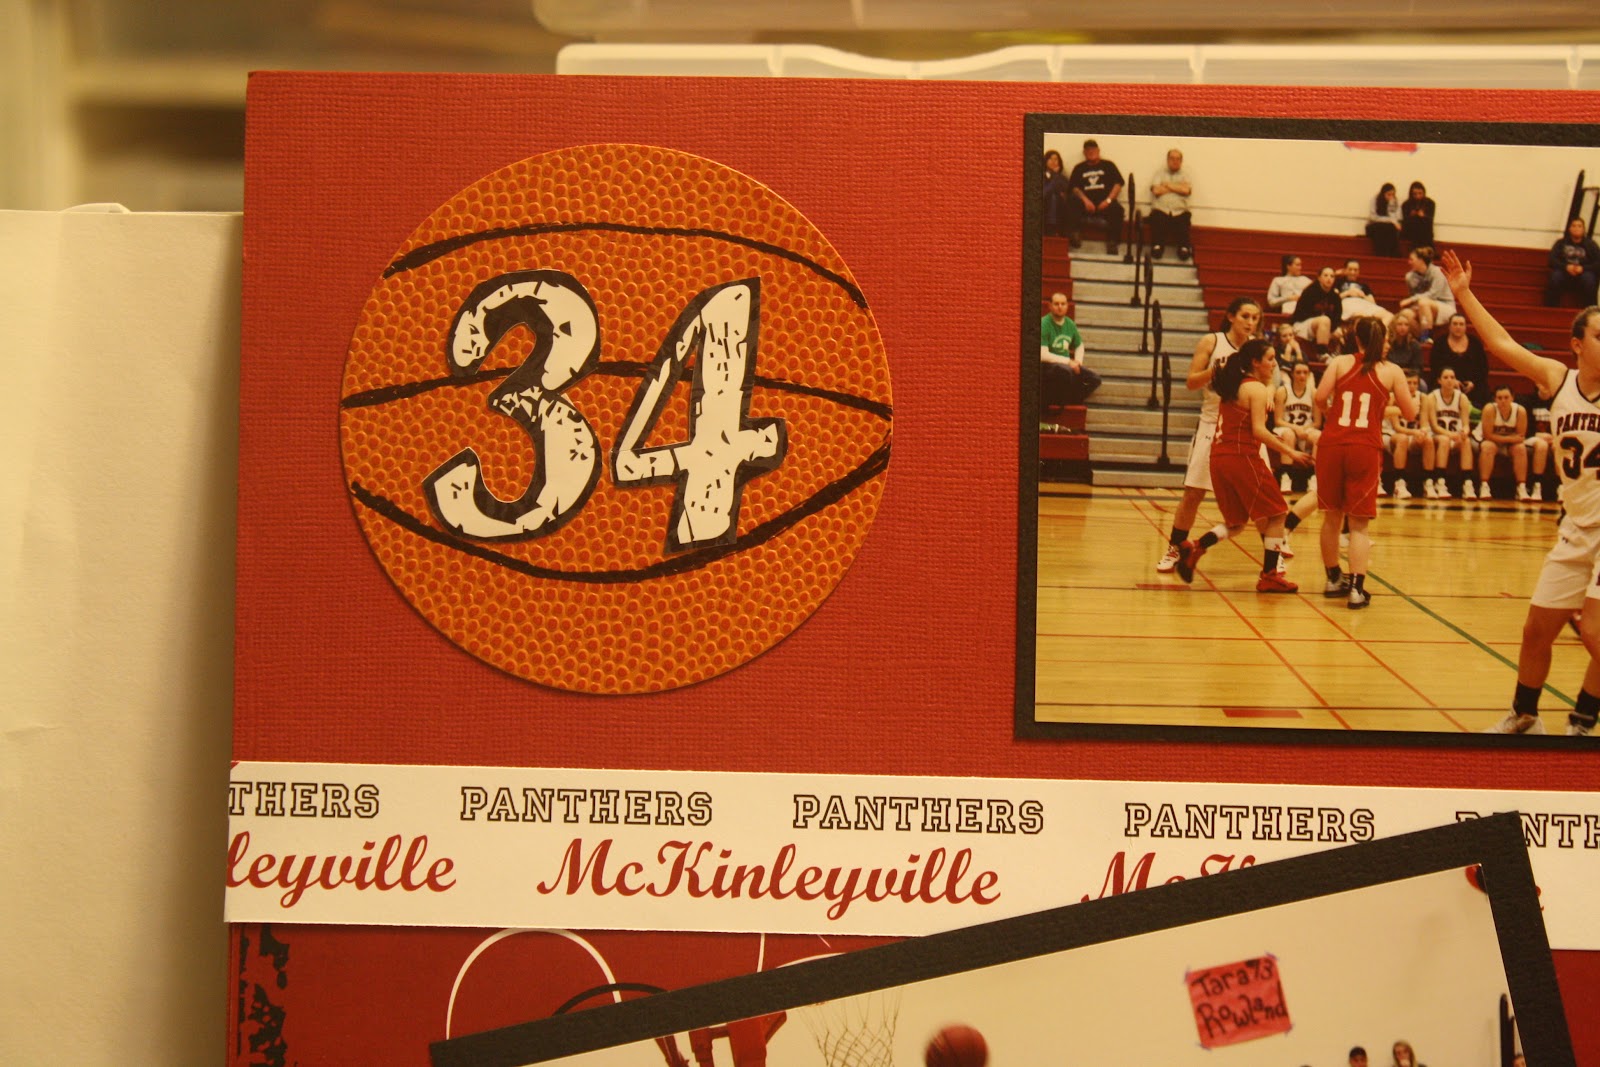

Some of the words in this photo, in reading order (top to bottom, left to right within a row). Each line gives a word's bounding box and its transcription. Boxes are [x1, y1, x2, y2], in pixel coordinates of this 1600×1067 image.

[422, 269, 789, 554] 34
[1338, 391, 1371, 428] 11
[1556, 412, 1600, 435] PANTH
[1560, 436, 1600, 480] 34
[229, 781, 380, 818] THERS
[460, 786, 712, 826] PANTHERS
[793, 794, 1044, 835] PANTHERS
[1124, 802, 1374, 842] PANTHERS
[226, 831, 456, 909] leyville
[537, 838, 1001, 921] McKinleyville
[1190, 968, 1249, 997] Tara
[1196, 979, 1289, 1039] Rowland
